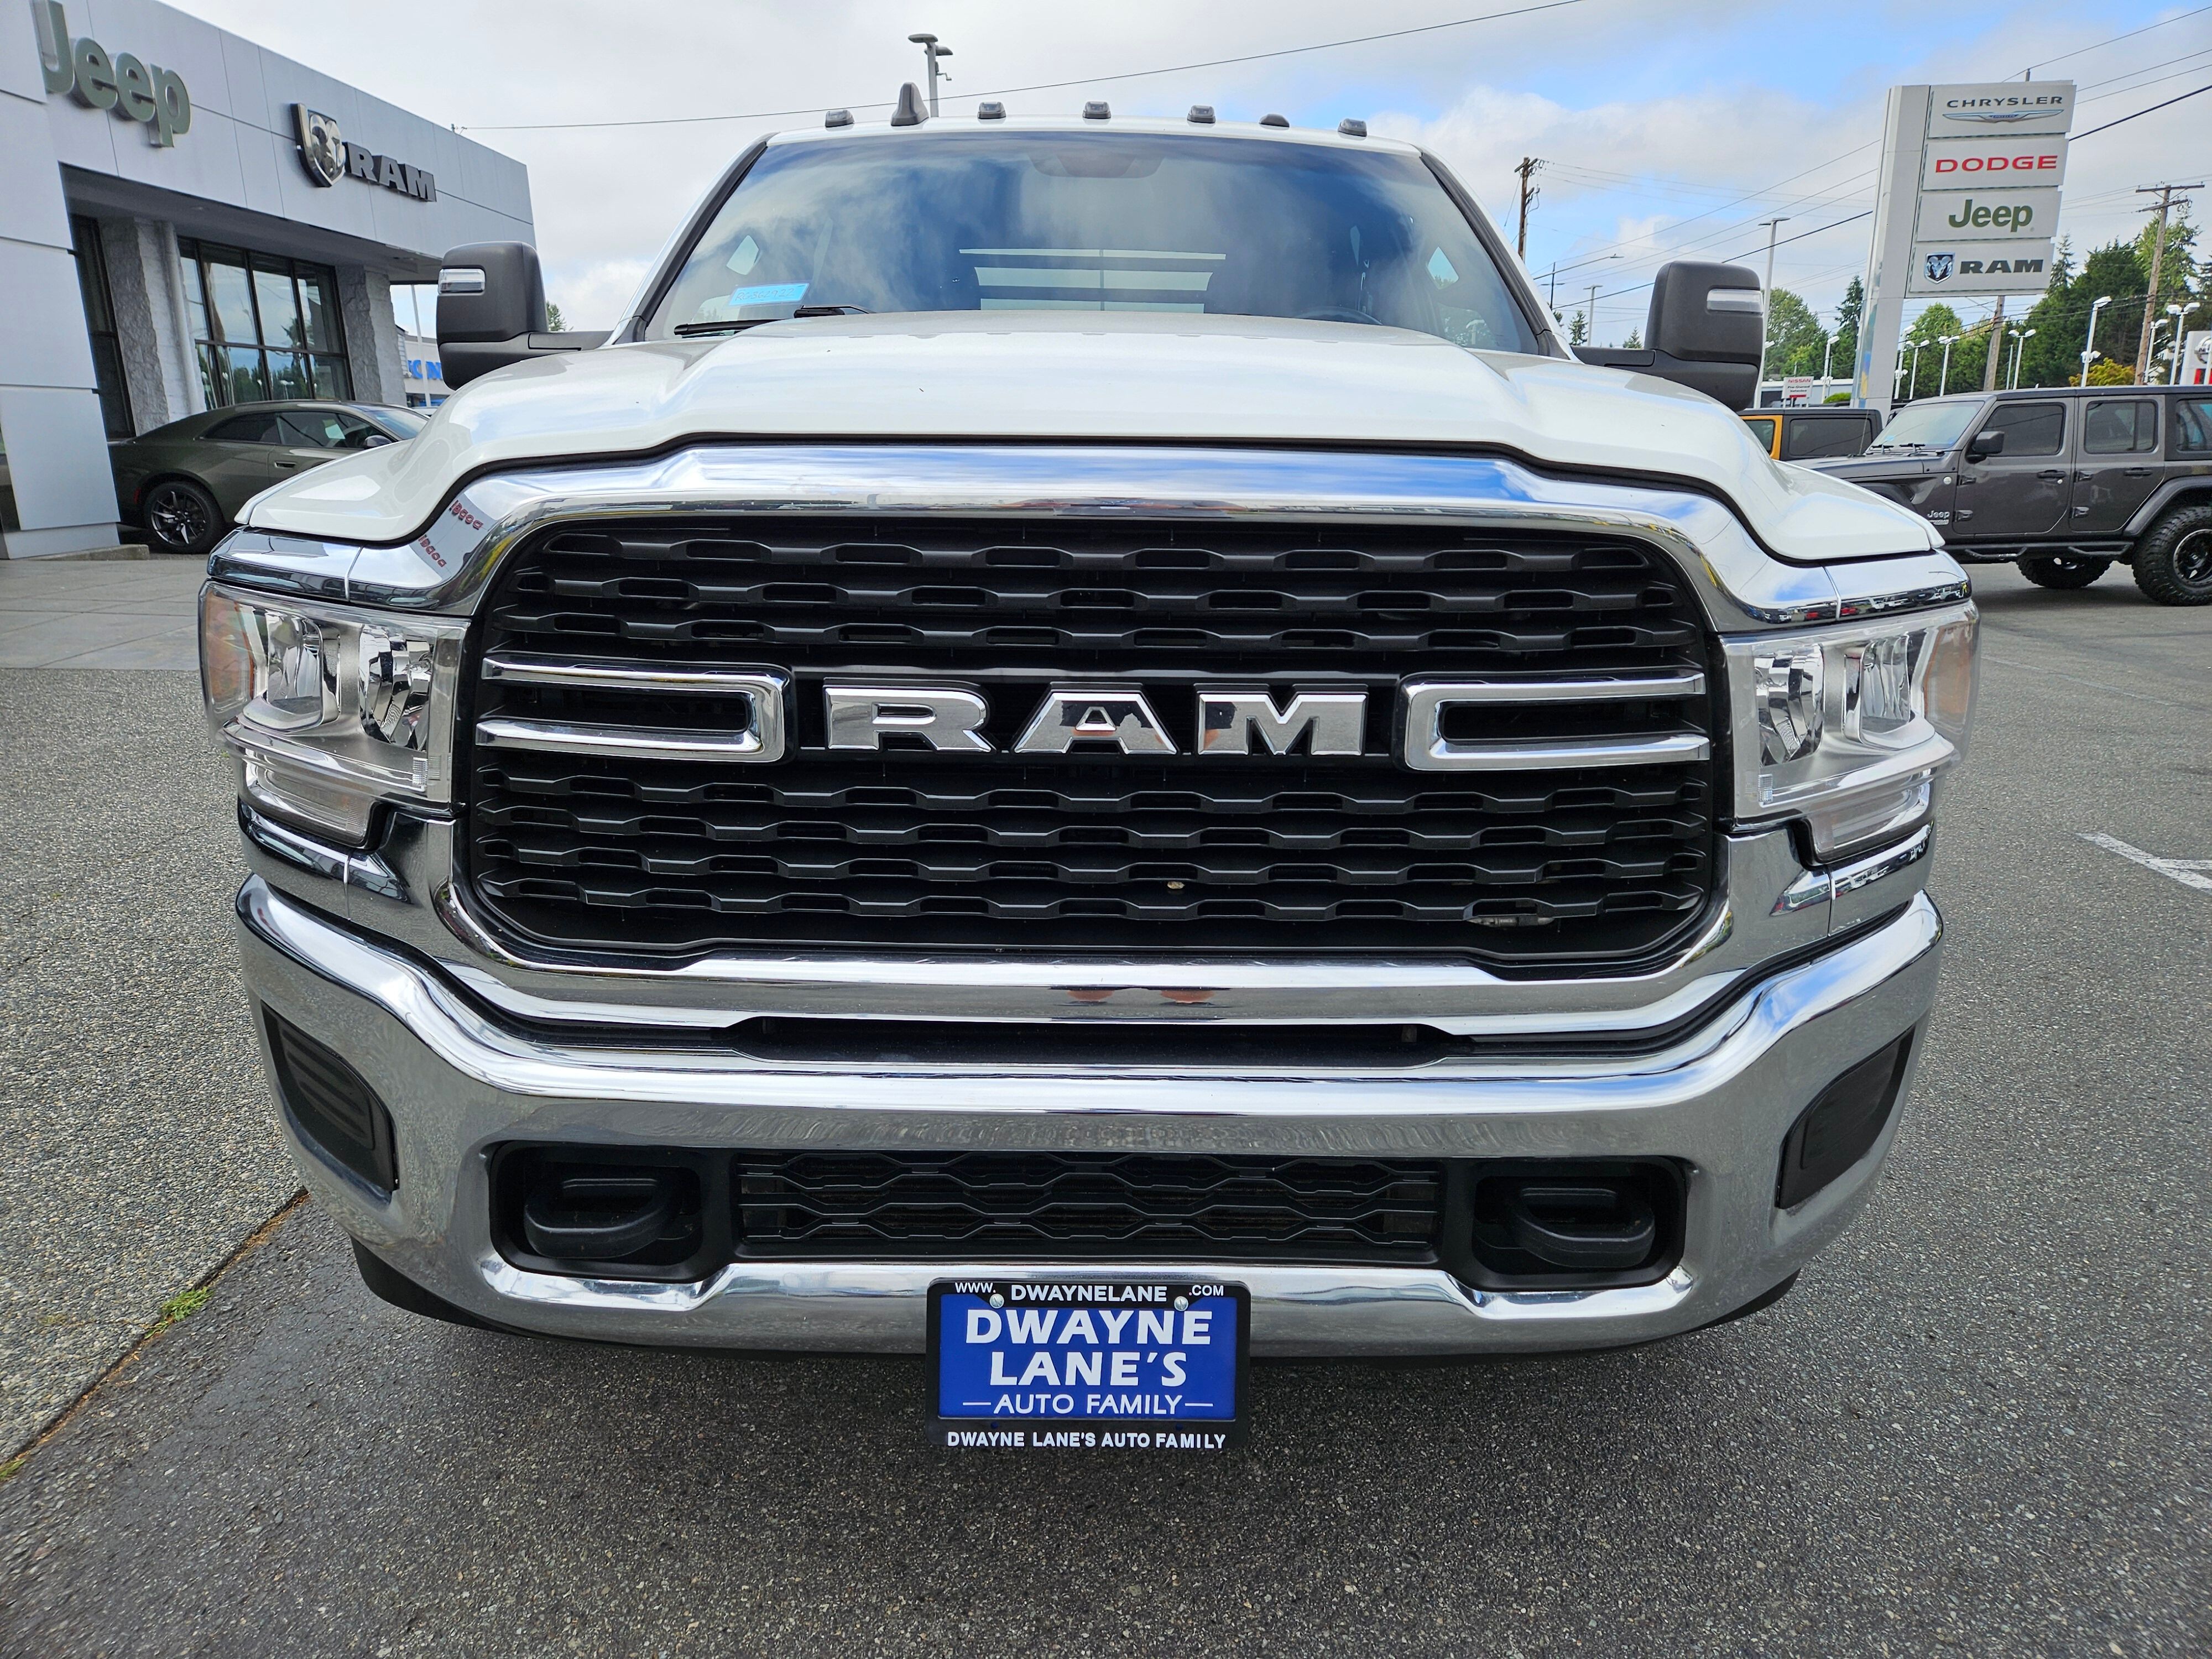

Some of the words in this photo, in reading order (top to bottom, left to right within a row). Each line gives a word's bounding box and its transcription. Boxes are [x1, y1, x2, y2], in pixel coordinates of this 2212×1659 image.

[36, 0, 191, 148] Jeep
[1947, 96, 2063, 108] CHRYSLER
[342, 142, 437, 202] RAM
[1935, 155, 2058, 173] DODGE
[1948, 199, 2033, 233] Jeep
[1959, 259, 2044, 274] RAM
[1927, 510, 1950, 519] Jeep
[824, 686, 1371, 756] RAM
[1011, 1285, 1168, 1302] DWAYNELANE
[966, 1309, 1213, 1345] DWAYNE
[989, 1351, 1187, 1387] LANE'S
[993, 1394, 1074, 1415] AUTO
[1086, 1394, 1183, 1415] FAMILY
[947, 1431, 1025, 1447] DWAYNE
[1032, 1432, 1097, 1448] LANE'S
[1100, 1432, 1152, 1448] AUTO
[1156, 1433, 1227, 1449] FAMILY
